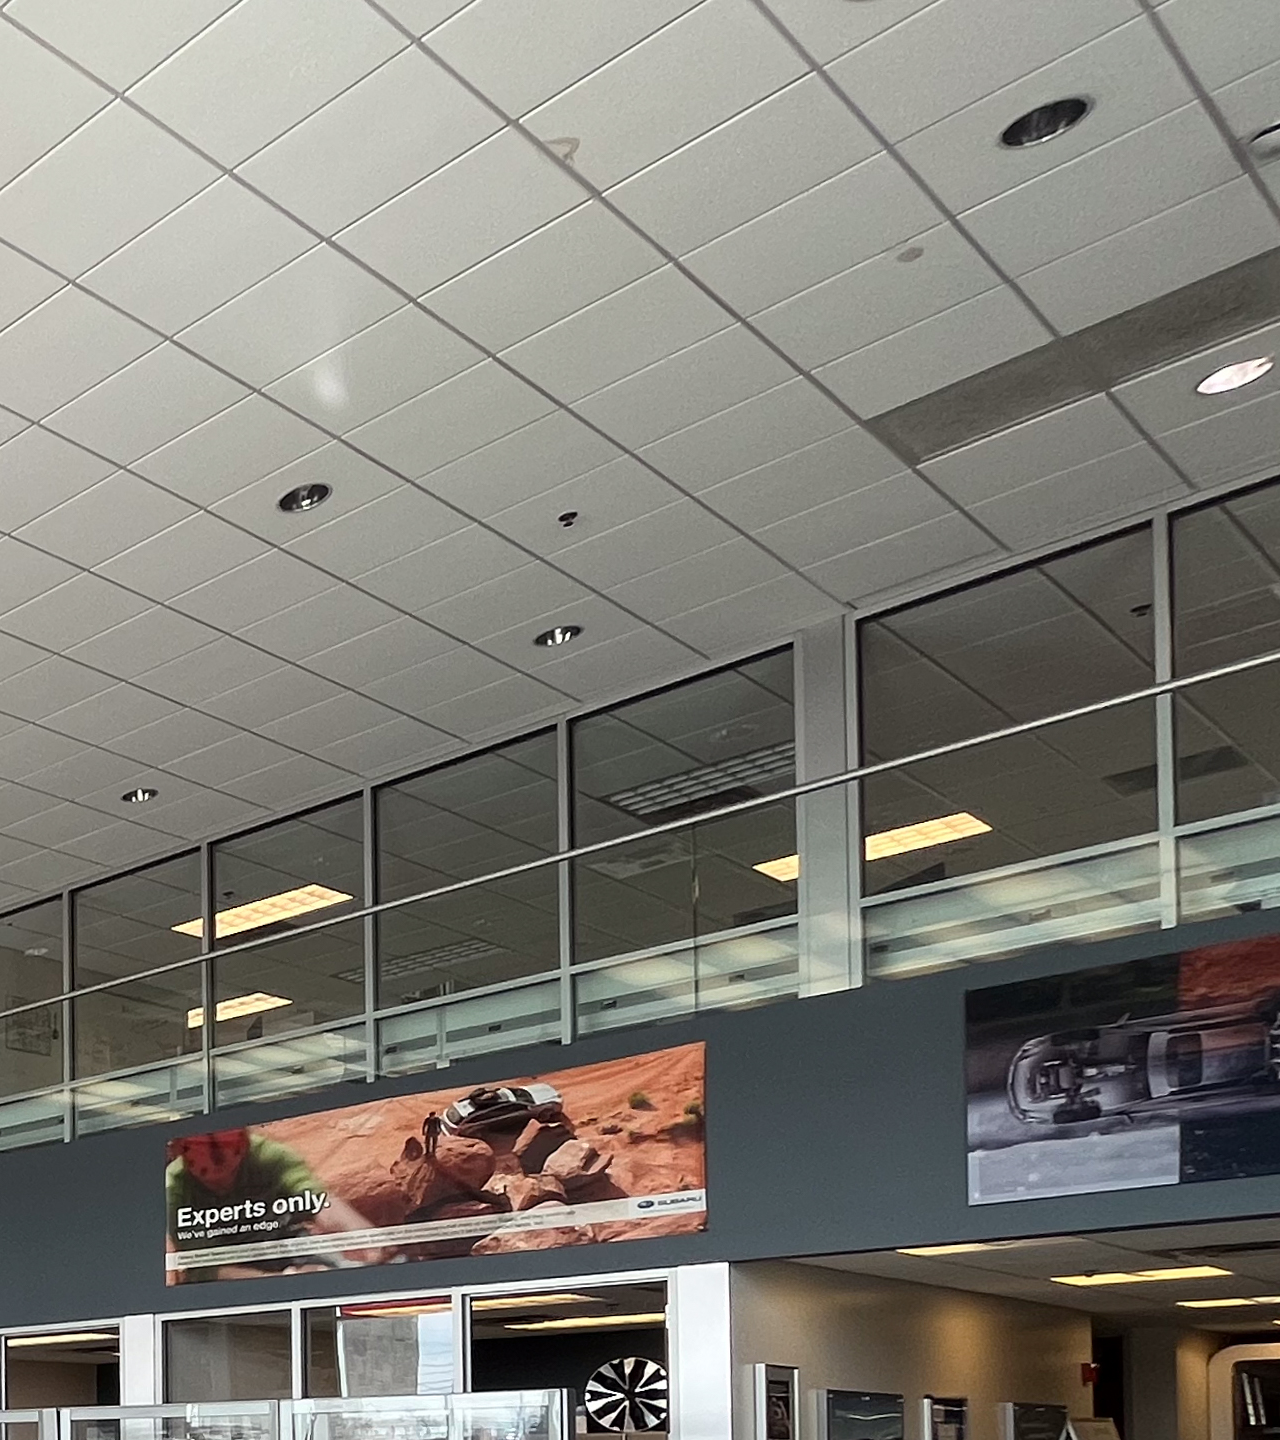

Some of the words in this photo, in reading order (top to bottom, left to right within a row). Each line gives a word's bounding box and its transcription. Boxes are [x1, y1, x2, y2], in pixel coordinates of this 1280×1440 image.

[657, 1196, 702, 1206] SUBARU
[177, 1199, 267, 1229] Experts
[272, 1190, 332, 1214] only.
[177, 1230, 205, 1240] We've
[206, 1225, 238, 1238] gained
[239, 1225, 252, 1233] an
